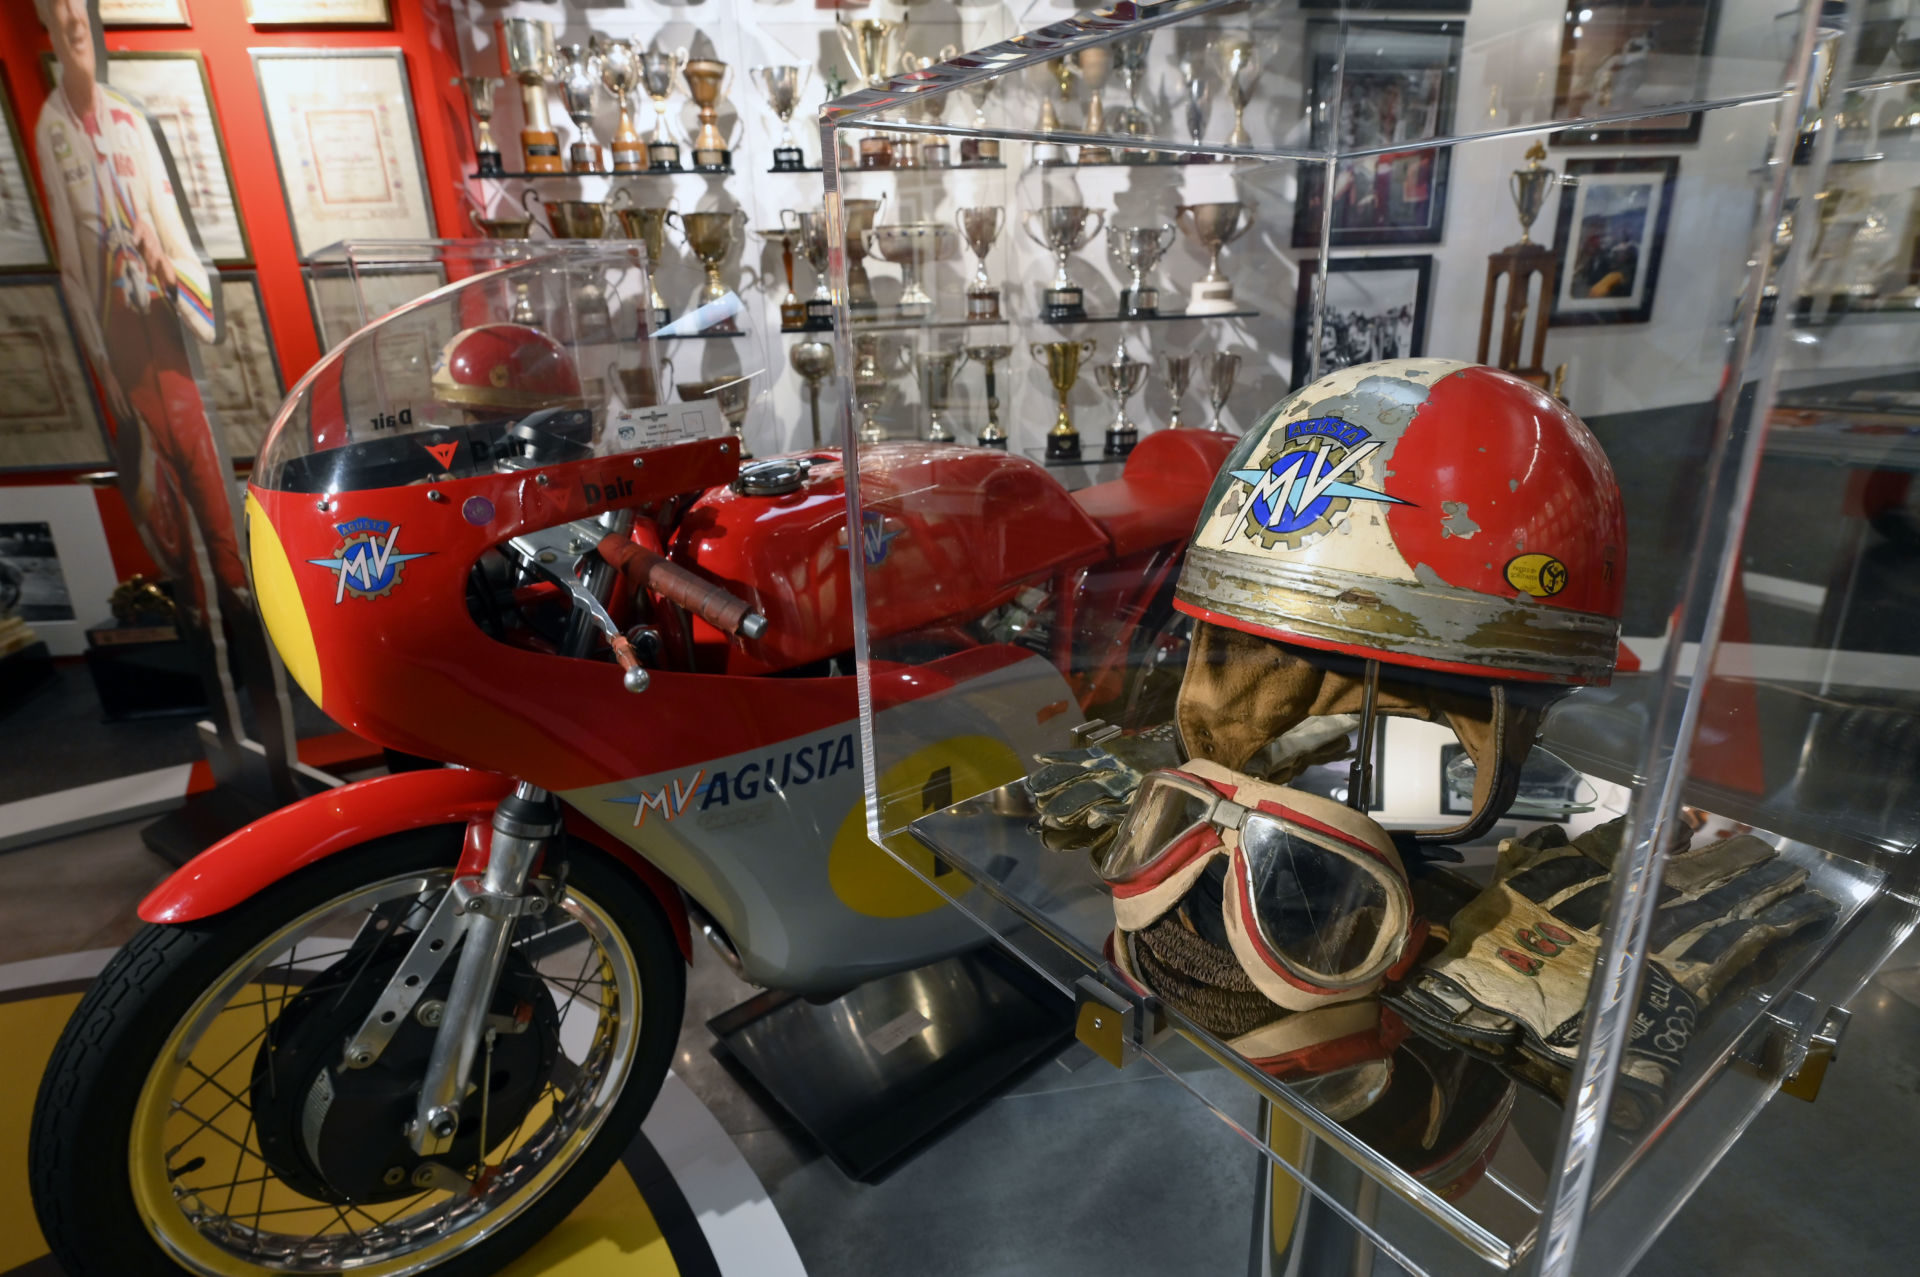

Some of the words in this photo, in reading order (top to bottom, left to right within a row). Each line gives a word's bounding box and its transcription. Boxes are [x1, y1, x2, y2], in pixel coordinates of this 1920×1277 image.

[1291, 421, 1359, 443] AGUSTA
[341, 520, 386, 535] AGUSTA
[1222, 440, 1387, 545] MV
[335, 525, 402, 605] MV
[633, 768, 707, 829] MV
[701, 733, 856, 811] AGUSTA
